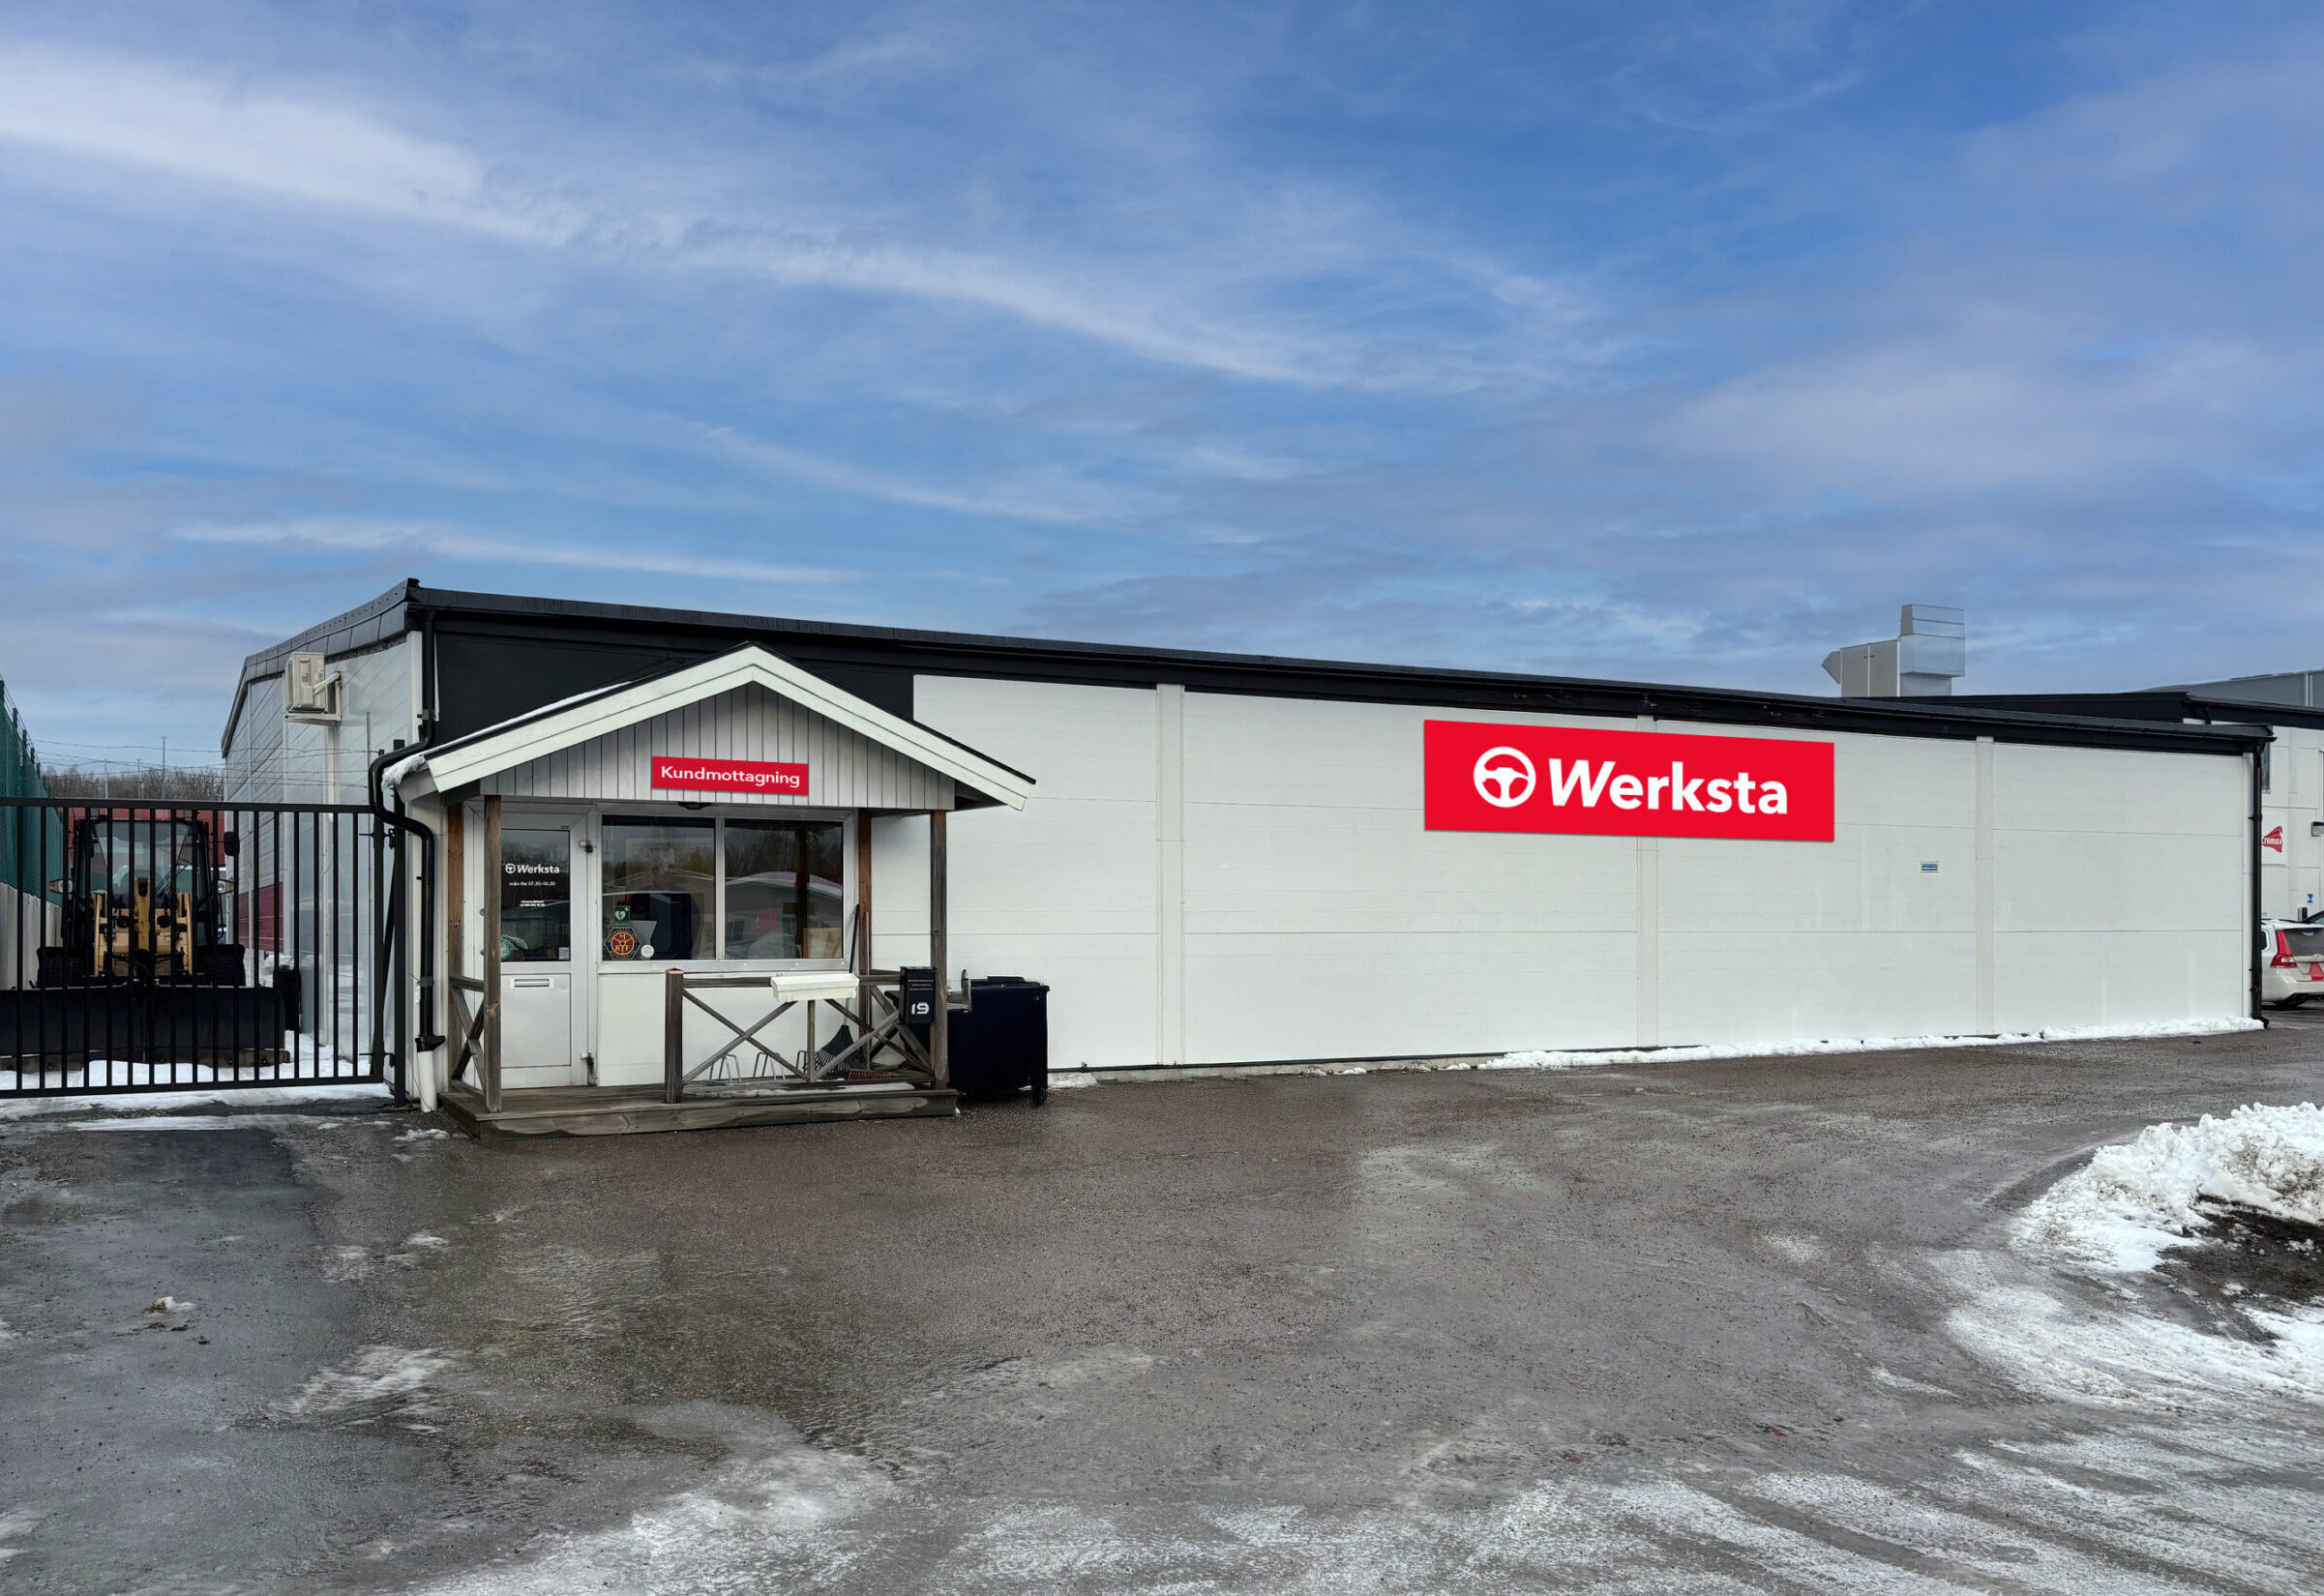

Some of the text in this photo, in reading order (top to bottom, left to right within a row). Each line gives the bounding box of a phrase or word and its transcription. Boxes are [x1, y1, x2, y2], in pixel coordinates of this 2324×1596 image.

[661, 765, 800, 788] Kundmottagning
[1548, 758, 1788, 814] Werksta
[517, 864, 560, 874] Werksta
[910, 1002, 930, 1015] 19
